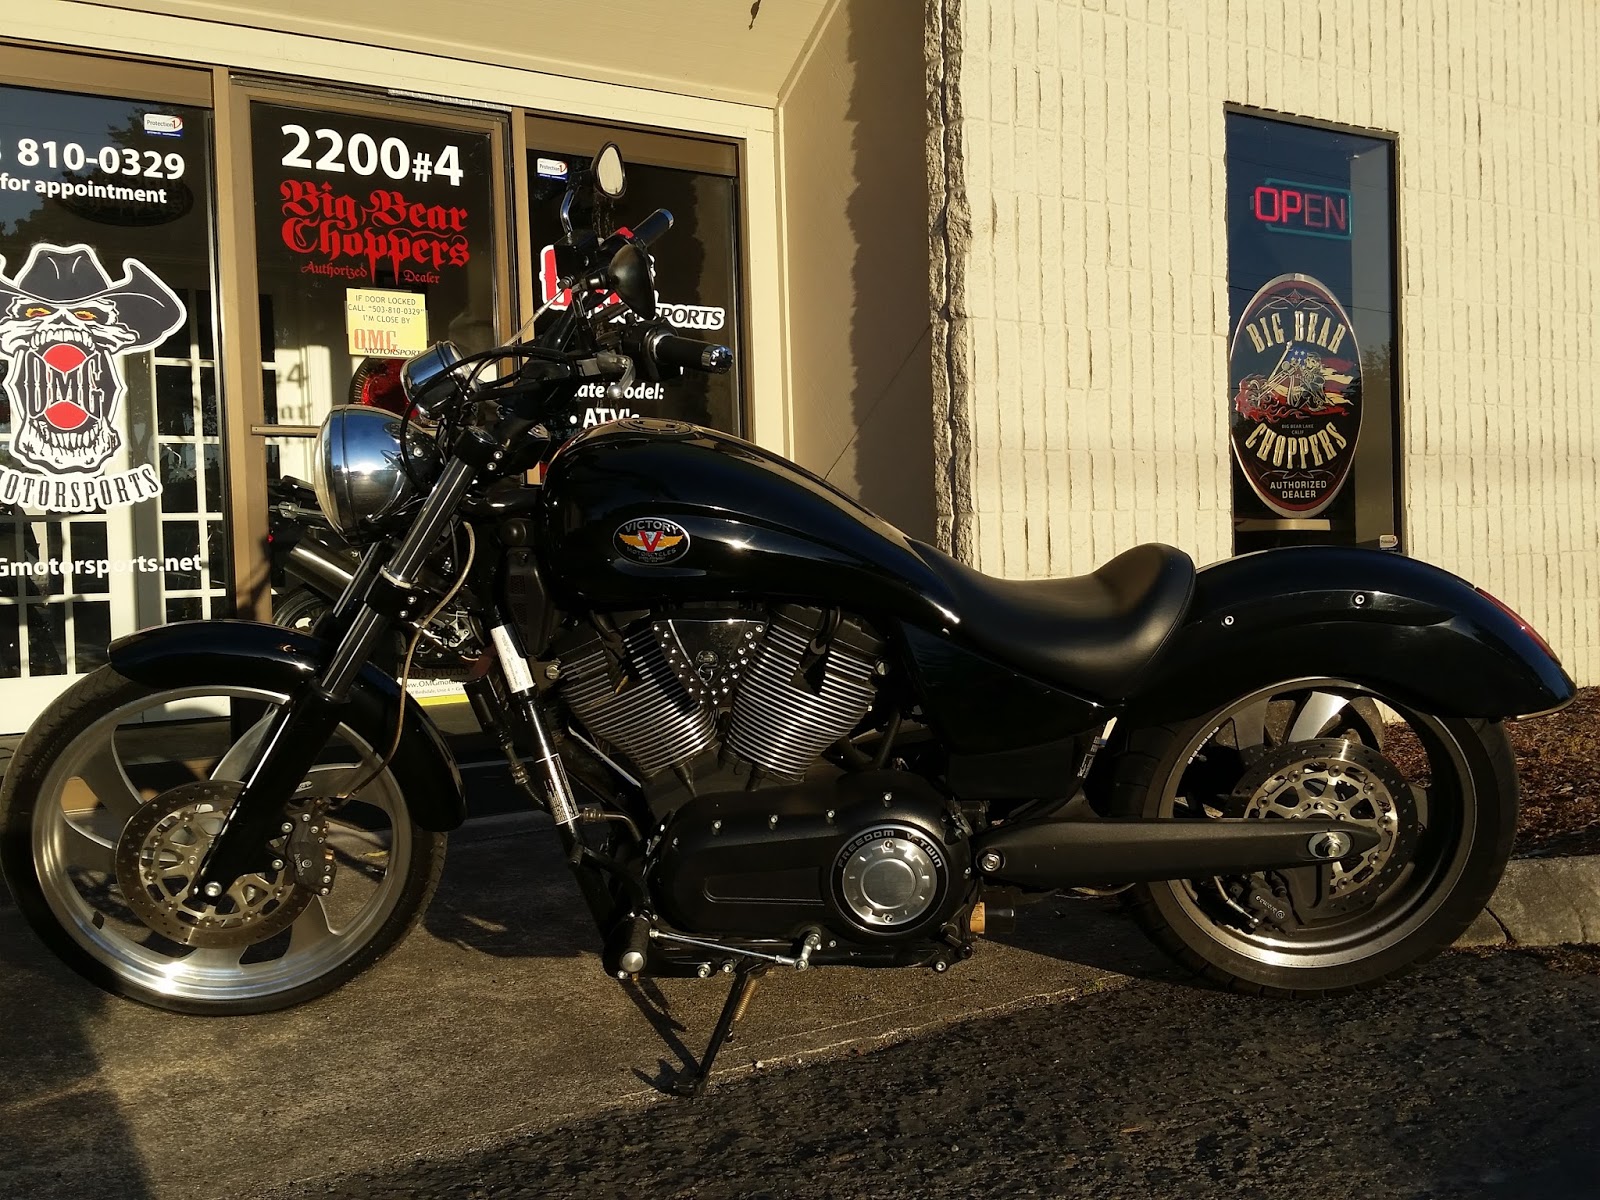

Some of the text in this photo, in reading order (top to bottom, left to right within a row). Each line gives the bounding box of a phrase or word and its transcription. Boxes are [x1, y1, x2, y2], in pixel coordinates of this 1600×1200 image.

[17, 138, 186, 180] 810-0329
[281, 124, 464, 187] 2200#4
[0, 173, 168, 204] for appointment
[280, 179, 469, 233] Big Bear
[1253, 186, 1347, 230] OPEN
[281, 217, 471, 285] Choppers
[301, 260, 441, 284] Authorized Dealer
[347, 303, 366, 312] CALL
[355, 294, 416, 306] IF DOOR LOCKED
[376, 315, 399, 324] CLOSE
[1246, 310, 1347, 354] BIG BEAR
[354, 328, 398, 353] OMG
[364, 347, 422, 356] MOTORSPORT
[25, 350, 105, 421] OMG
[574, 382, 665, 400] ate odel:
[1245, 421, 1347, 470] CHOPPERS
[0, 467, 160, 509] OTORSPORTS
[1270, 480, 1327, 489] AUTHORIZED
[1282, 490, 1316, 498] DEALER
[625, 520, 679, 535] VICTORY
[837, 829, 895, 868] FREEDOM
